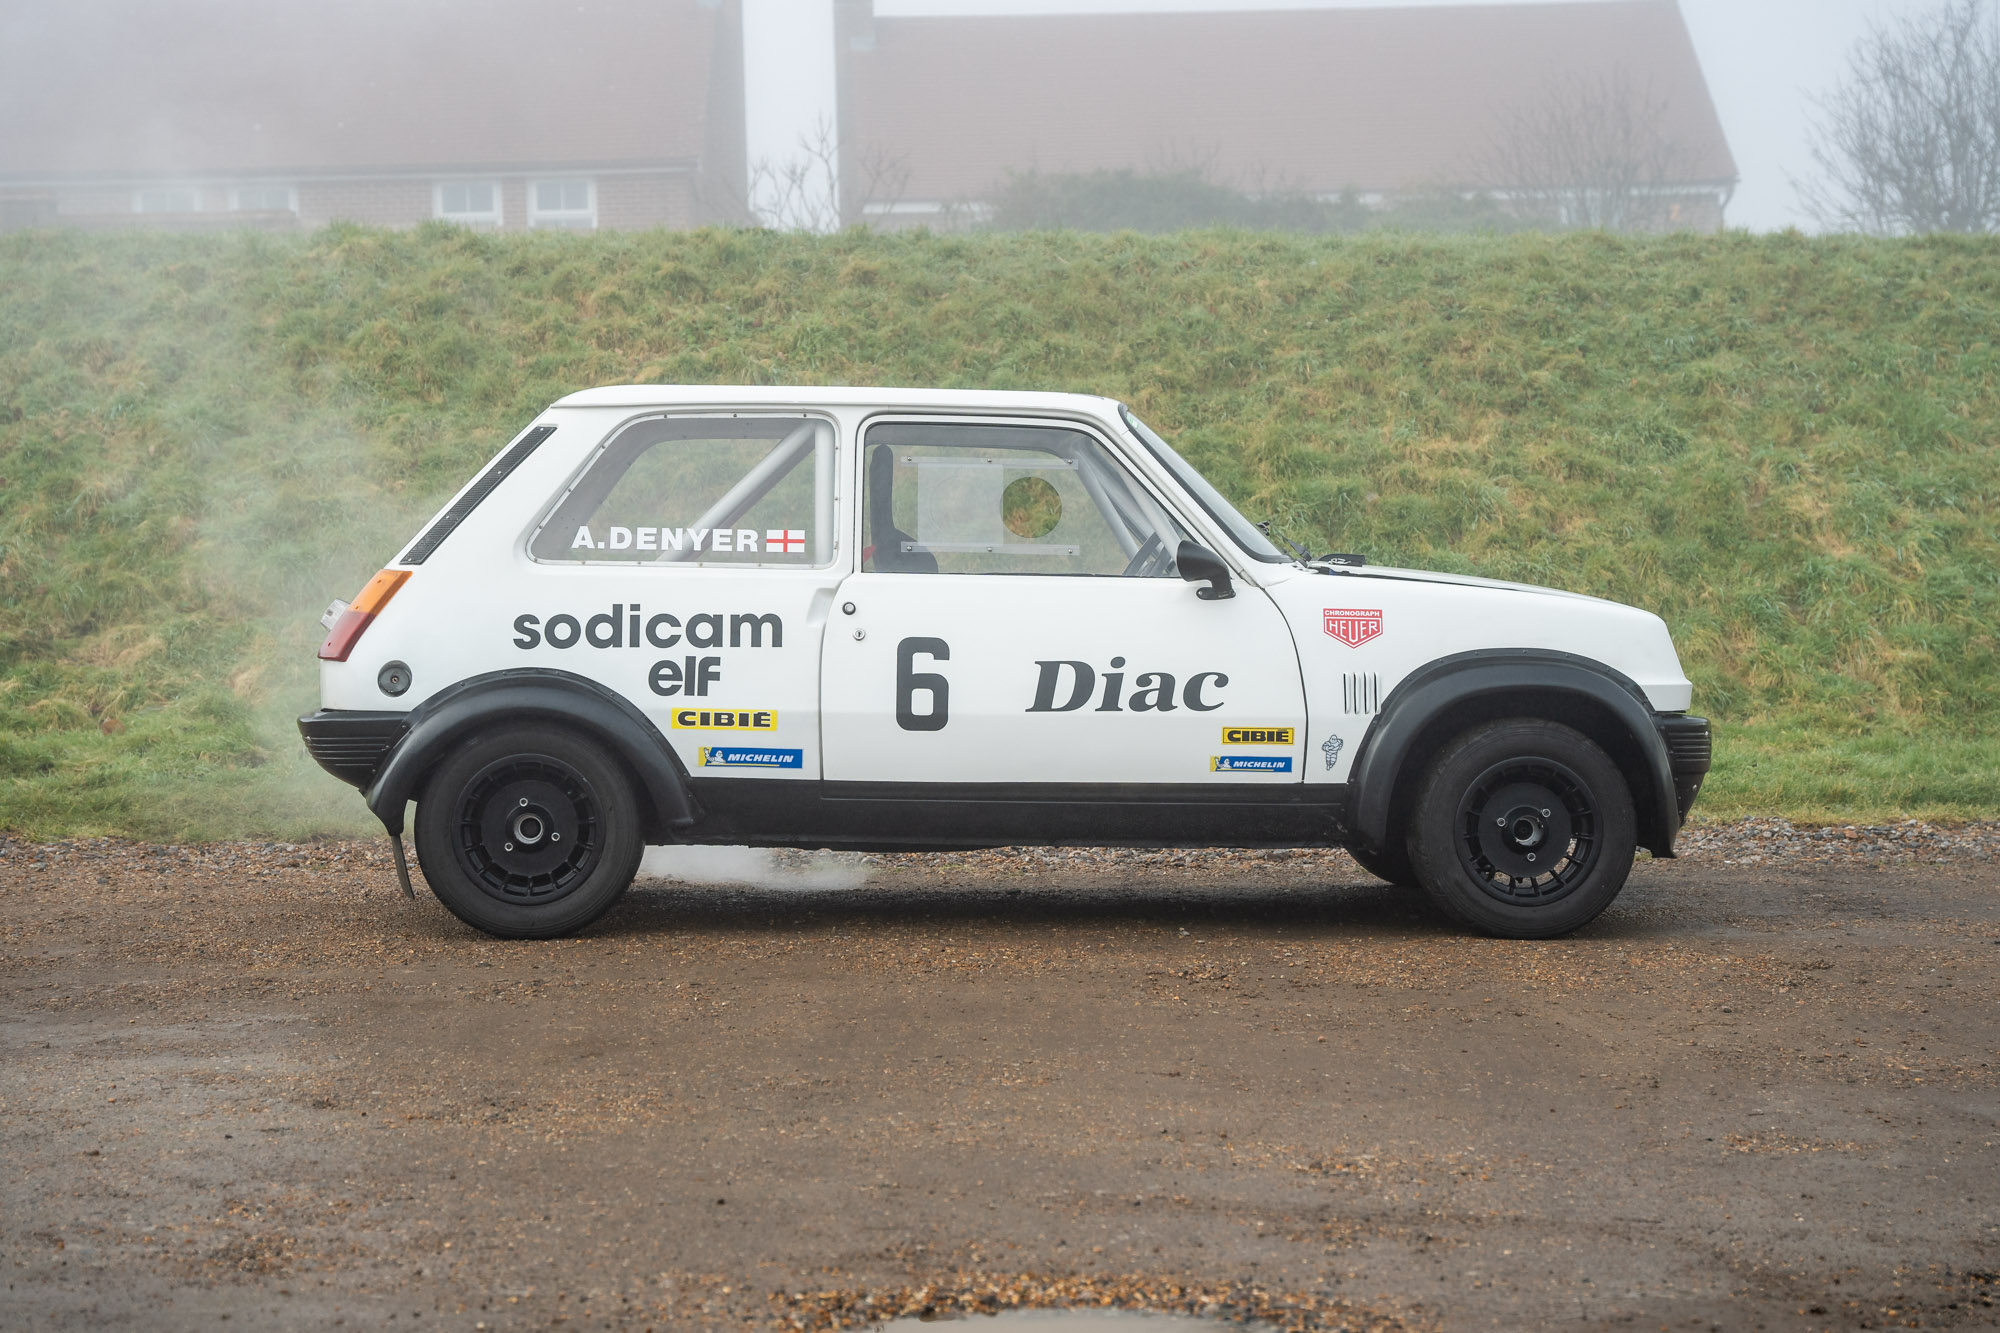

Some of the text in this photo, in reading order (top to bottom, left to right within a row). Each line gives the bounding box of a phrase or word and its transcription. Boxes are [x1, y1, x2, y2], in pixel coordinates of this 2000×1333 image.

[571, 525, 759, 552] A.DENYER
[512, 603, 783, 650] sodicam
[1329, 620, 1378, 642] HEUER
[648, 656, 721, 697] elf
[896, 637, 950, 731] 6
[1025, 656, 1229, 712] Diac
[727, 753, 794, 763] MICHELIN
[1233, 760, 1286, 768] MICHELIN
